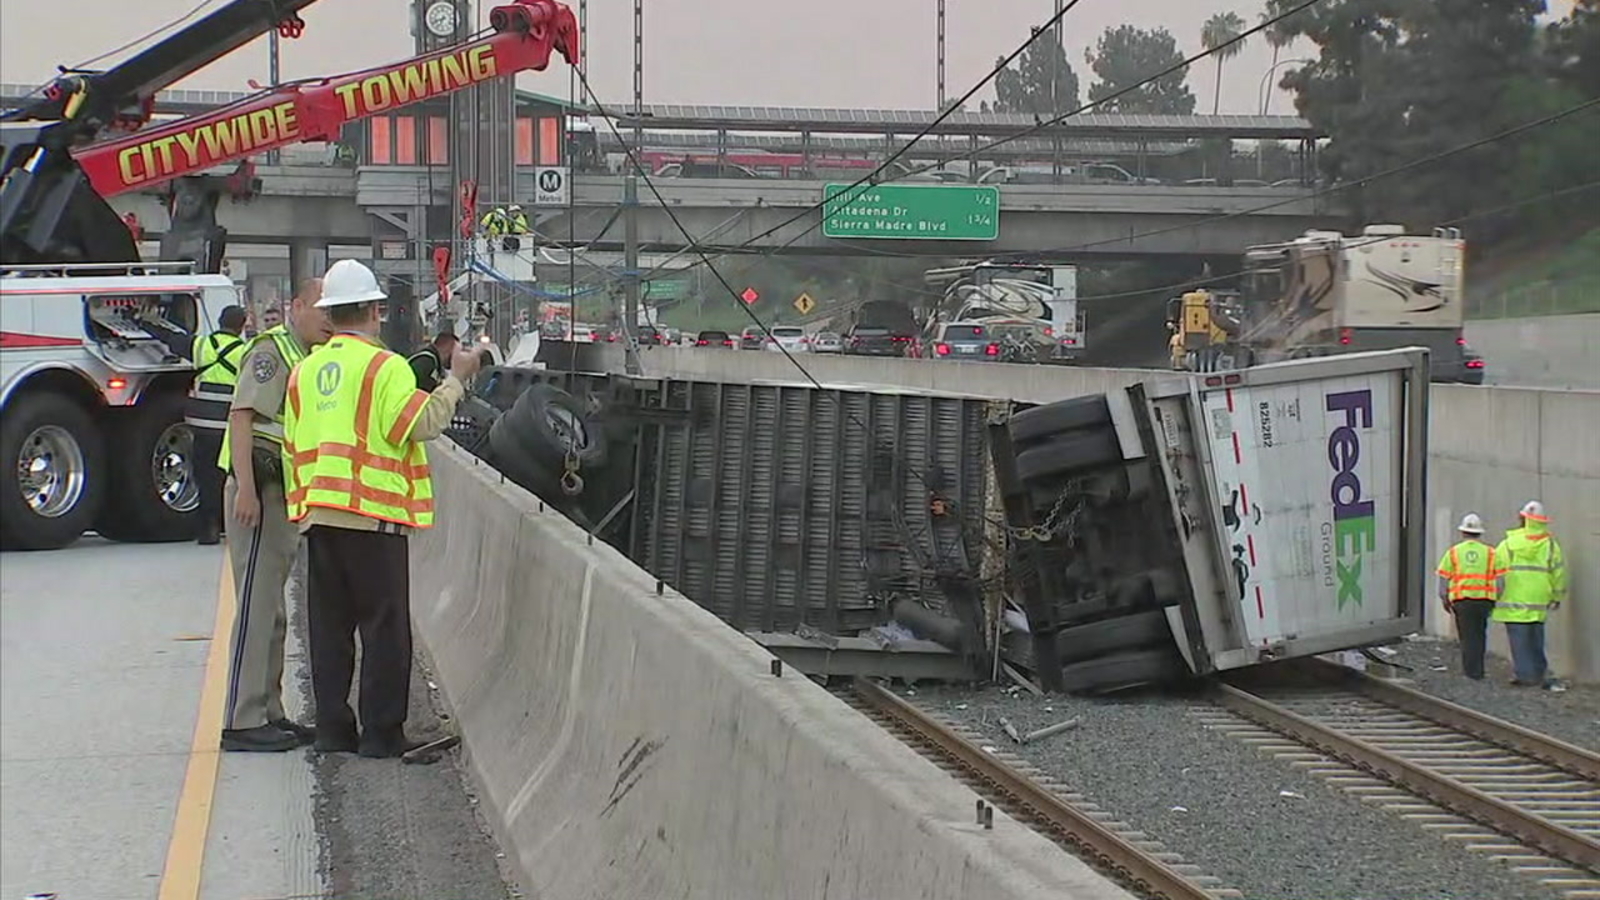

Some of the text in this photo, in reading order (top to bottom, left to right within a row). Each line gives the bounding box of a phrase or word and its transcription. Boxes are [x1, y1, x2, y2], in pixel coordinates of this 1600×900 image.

[118, 43, 498, 186] CITYWIDE TOWING
[859, 193, 881, 202] Ave
[893, 208, 908, 216] Dr
[830, 220, 947, 231] Sierra Madre Blvd
[1326, 389, 1376, 612] FedEx
[1321, 522, 1335, 587] Ground
